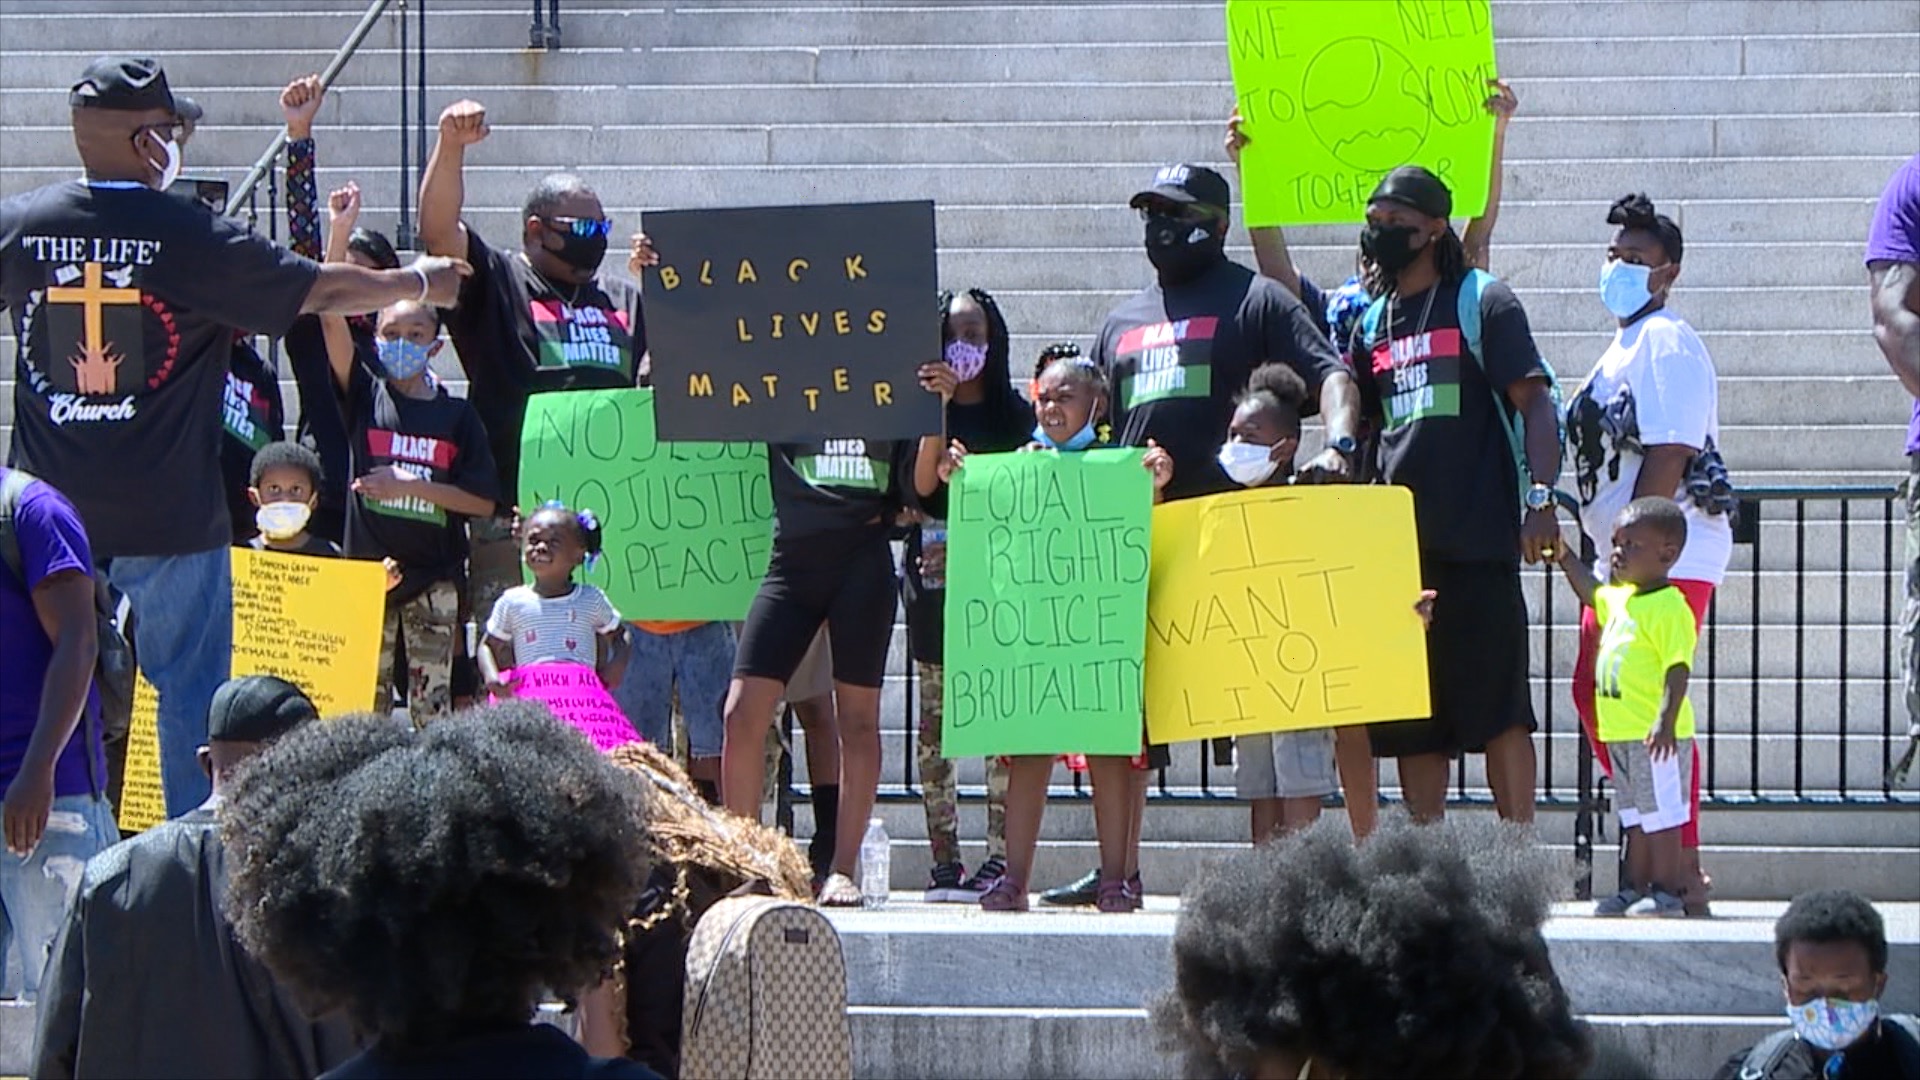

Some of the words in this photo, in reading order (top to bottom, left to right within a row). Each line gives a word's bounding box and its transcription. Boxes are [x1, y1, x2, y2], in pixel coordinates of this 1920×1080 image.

[1228, 3, 1296, 60] WE
[1396, 0, 1489, 45] NEED
[1240, 88, 1295, 124] TO
[1288, 157, 1458, 215] TOGER
[22, 236, 86, 262] "THE
[659, 254, 867, 290] BLACK
[568, 321, 611, 343] LIVES
[737, 309, 887, 342] LIVES
[562, 341, 620, 365] MATTER
[1142, 345, 1180, 372] LIVES
[688, 368, 893, 412] MATTER
[1133, 366, 1186, 397] MATTER
[50, 393, 136, 426] Church
[538, 397, 623, 462] NO
[391, 431, 438, 461] BLACK
[815, 454, 874, 480] MATTER
[824, 438, 866, 455] LIVES
[616, 469, 774, 532] JUSTIC
[960, 464, 1125, 524] EQUAL
[988, 525, 1149, 586] RIGHTS
[1209, 497, 1316, 575] I
[625, 534, 767, 593] PEACE
[965, 594, 1124, 648] POLICE
[1147, 565, 1355, 646] WANT
[1227, 631, 1318, 676] TO
[951, 657, 1145, 729] BRUTALITY
[1184, 666, 1363, 727] LIVE
